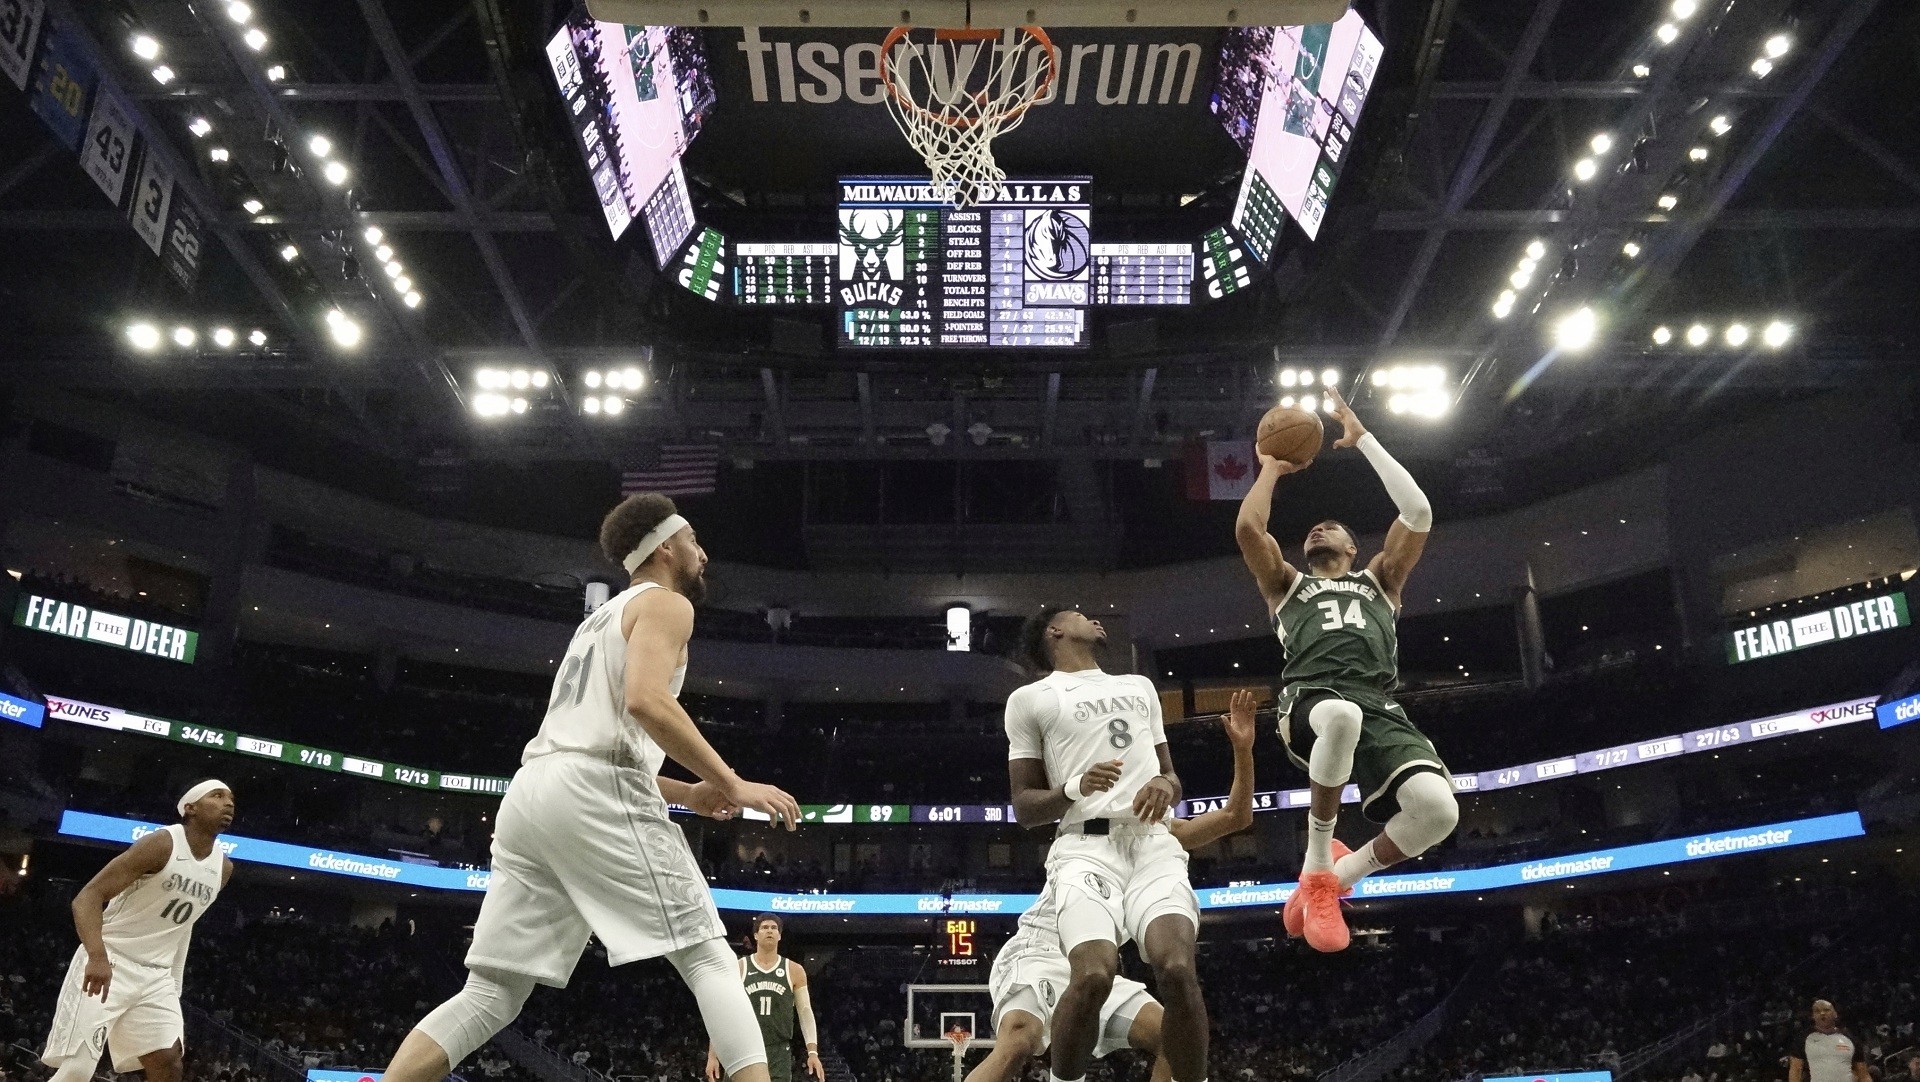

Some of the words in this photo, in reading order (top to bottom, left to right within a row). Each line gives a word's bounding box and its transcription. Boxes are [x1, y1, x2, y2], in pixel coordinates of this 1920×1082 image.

[96, 125, 125, 174] 43
[144, 179, 163, 223] 3
[948, 212, 980, 221] ASSISTS
[918, 226, 924, 236] 3
[947, 225, 982, 233] BLOCKS
[1005, 226, 1010, 236] 1
[171, 218, 199, 268] 22
[700, 232, 718, 268] FEAR
[803, 245, 814, 254] AST
[918, 238, 924, 248] 2
[948, 238, 980, 246] STEALS
[946, 250, 962, 258] OFF
[964, 250, 982, 258] REB
[916, 262, 928, 272] 30
[946, 262, 962, 270] DEF
[964, 262, 982, 270] REB
[916, 275, 928, 284] 10
[943, 286, 968, 294] TOTAL
[970, 286, 984, 294] FLS
[840, 282, 903, 306] BUCKS
[916, 300, 928, 308] 11
[944, 298, 968, 306] BENCH
[970, 298, 984, 306] PTS
[1026, 284, 1087, 304] MAVS
[944, 323, 983, 331] 3-POINTERS
[940, 335, 958, 343] FREE
[959, 335, 988, 343] THROWS
[1296, 578, 1378, 603] MILWAUKEE
[1318, 599, 1366, 630] 34
[25, 595, 87, 638] FEAR
[95, 621, 124, 636] THE
[130, 609, 187, 660] DEER
[1734, 620, 1792, 661] FEAR
[1798, 622, 1828, 636] THE
[1834, 596, 1898, 638] DEER
[58, 702, 111, 722] KUNES
[1074, 696, 1149, 723] MAVS
[1820, 702, 1874, 721] KUNES
[1108, 718, 1133, 749] 8
[143, 720, 162, 733] FG
[181, 726, 224, 746] 34/54
[250, 740, 276, 754] 3PT
[300, 750, 332, 766] 9/18
[361, 762, 378, 774] FT
[394, 768, 429, 786] 12/13
[442, 776, 468, 788] TOL
[1498, 770, 1520, 785] 4/9
[1543, 764, 1559, 775] FT
[1595, 750, 1628, 767] 7/27
[1643, 742, 1670, 756] 3PT
[1696, 728, 1741, 748] 27/63
[1758, 722, 1778, 734] FG
[870, 806, 892, 821] 89
[928, 806, 962, 822] 6:01
[984, 808, 1002, 821] 3RD
[1686, 828, 1793, 856] ticketmaster
[309, 852, 402, 880] ticketmaster
[1521, 856, 1614, 880] ticketmaster
[162, 873, 214, 906] MAVS
[1362, 876, 1456, 896] ticketmaster
[160, 898, 194, 924] 10
[771, 896, 856, 912] ticketmaster
[947, 920, 975, 933] 6:01
[952, 934, 972, 956] 15
[759, 996, 772, 1016] 11
